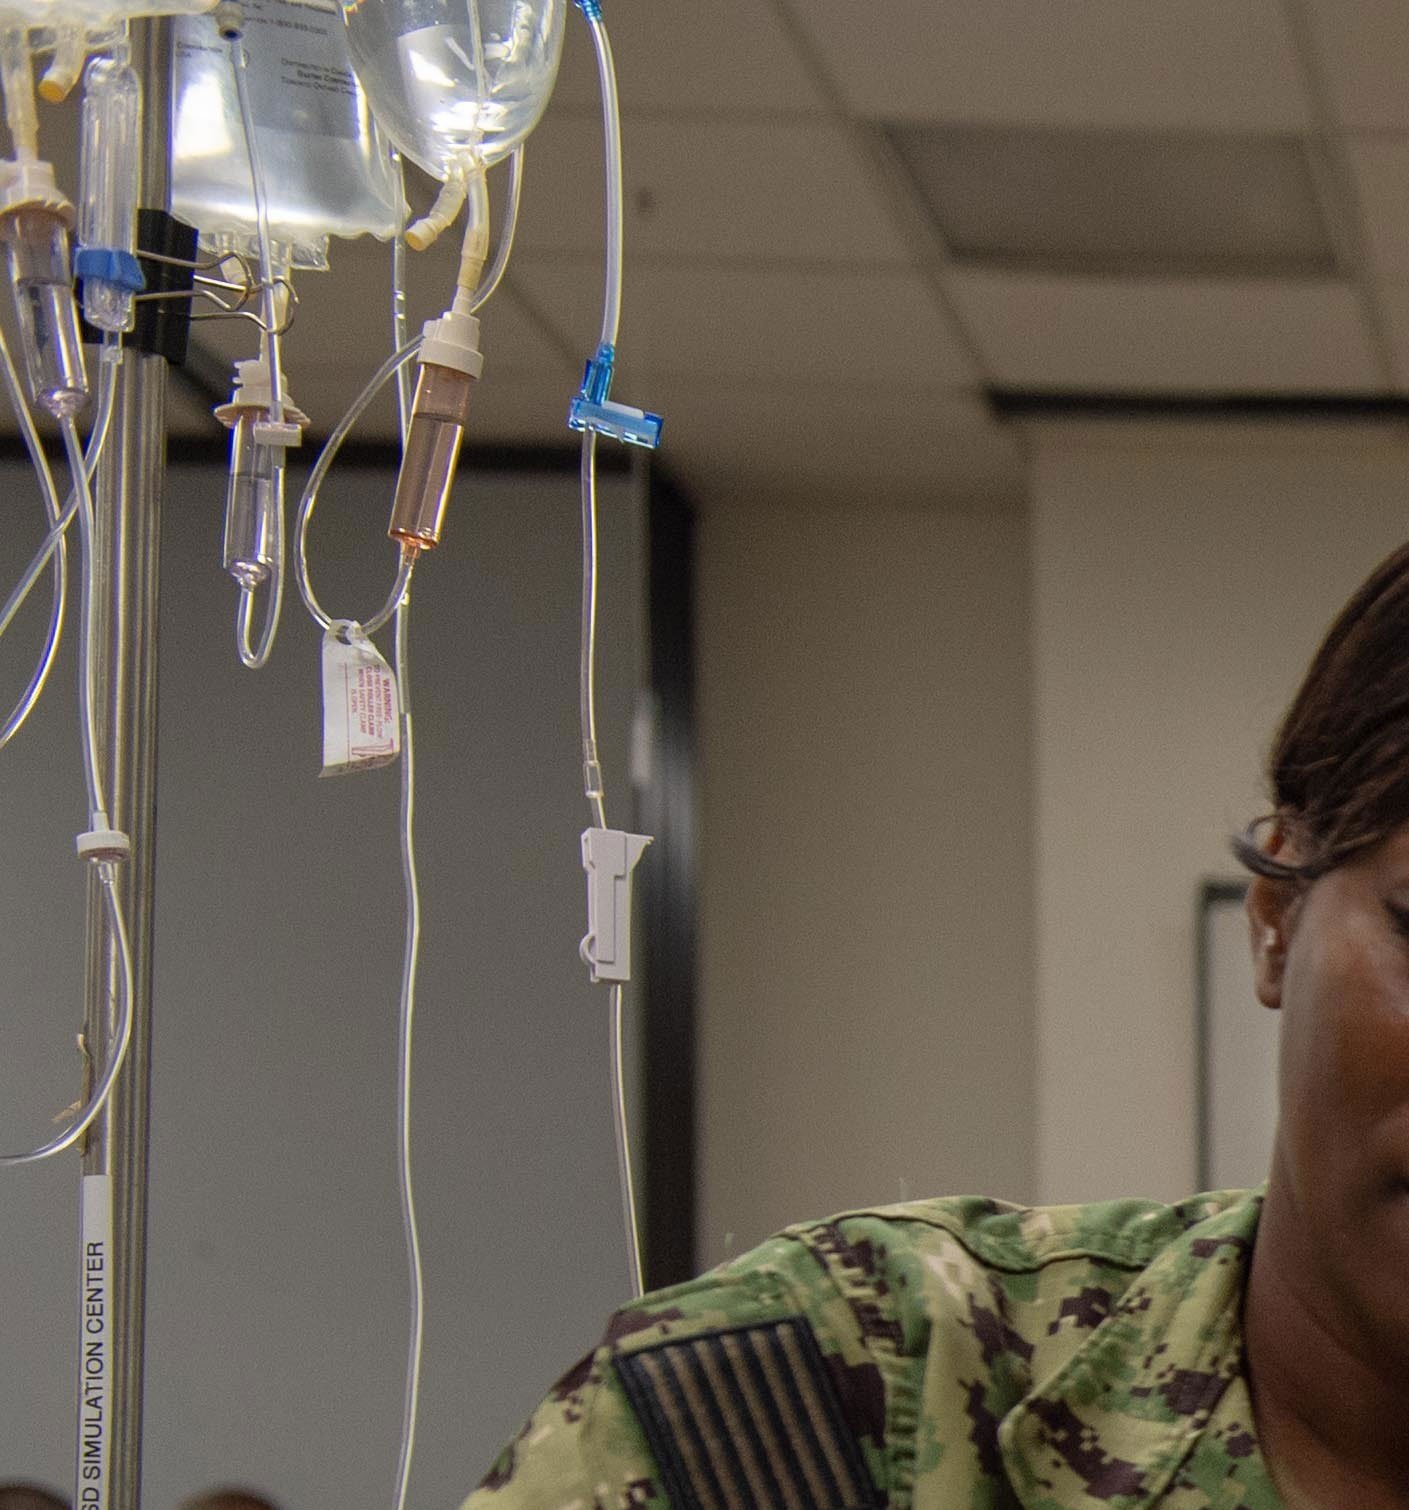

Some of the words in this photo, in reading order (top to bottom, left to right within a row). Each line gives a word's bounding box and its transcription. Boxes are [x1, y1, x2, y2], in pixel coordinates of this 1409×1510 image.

[383, 679, 393, 723] WARNING:
[86, 1242, 104, 1334] CENTER
[83, 1342, 103, 1480] SIMULATION
